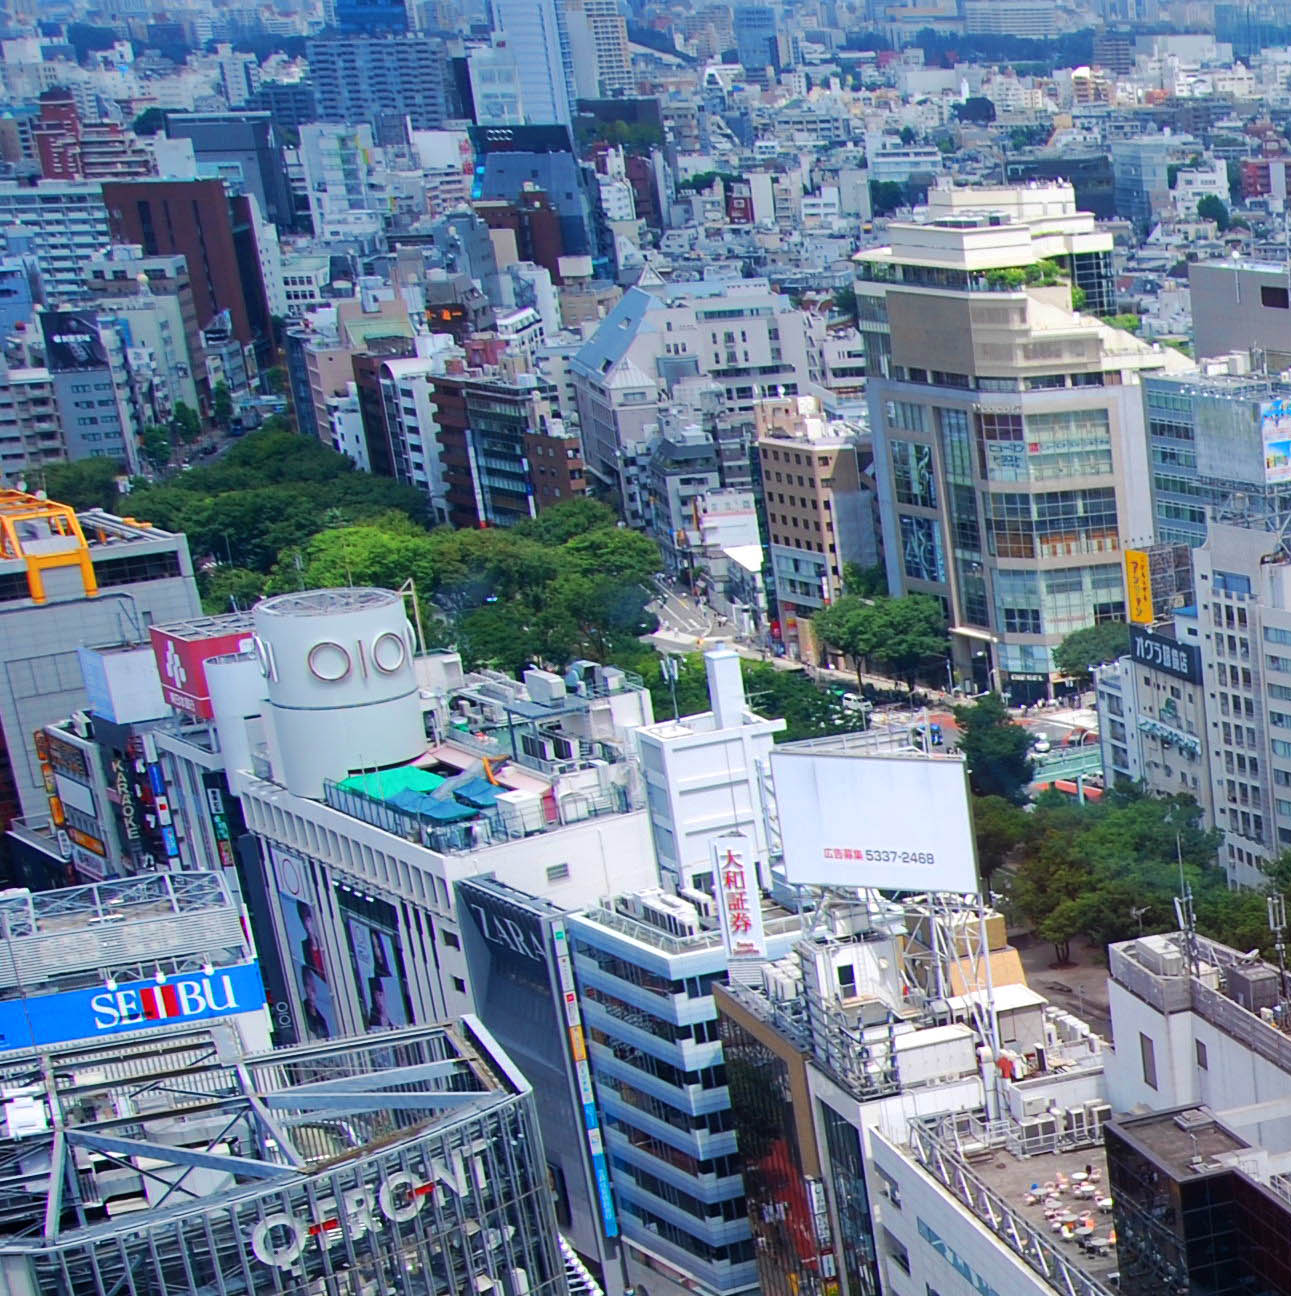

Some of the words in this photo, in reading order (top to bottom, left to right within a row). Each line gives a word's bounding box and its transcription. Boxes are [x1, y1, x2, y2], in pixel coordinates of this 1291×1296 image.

[111, 758, 141, 840] KARAOKE
[865, 849, 936, 865] 5337-2468
[720, 849, 753, 934] 大和証券
[471, 903, 547, 962] ZARA
[91, 974, 240, 1030] SEIBU
